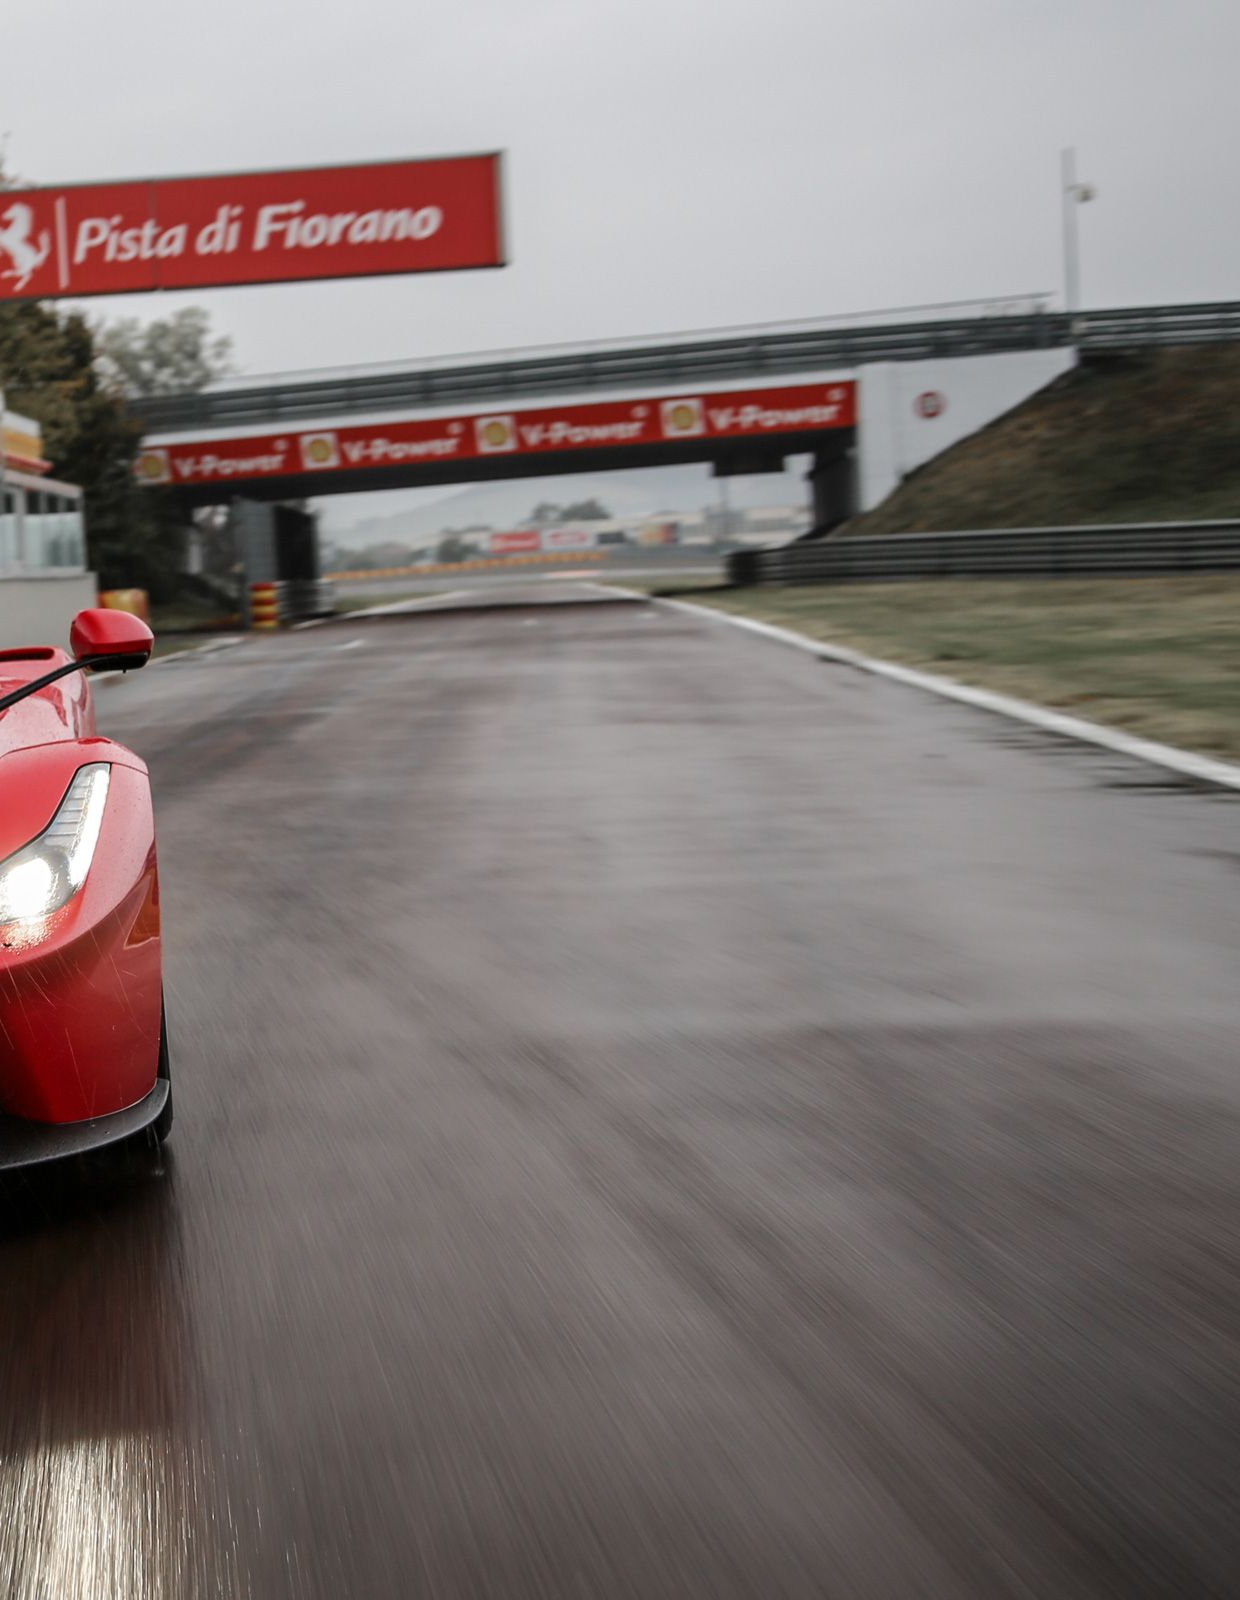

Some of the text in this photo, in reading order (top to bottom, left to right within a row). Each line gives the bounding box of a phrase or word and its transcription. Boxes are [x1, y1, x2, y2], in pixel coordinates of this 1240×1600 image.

[73, 200, 444, 265] Pista di Fiorano
[707, 405, 842, 431] V-Power
[519, 421, 645, 446] V-Power
[341, 437, 460, 462] V-Power
[173, 454, 286, 478] V-Power
